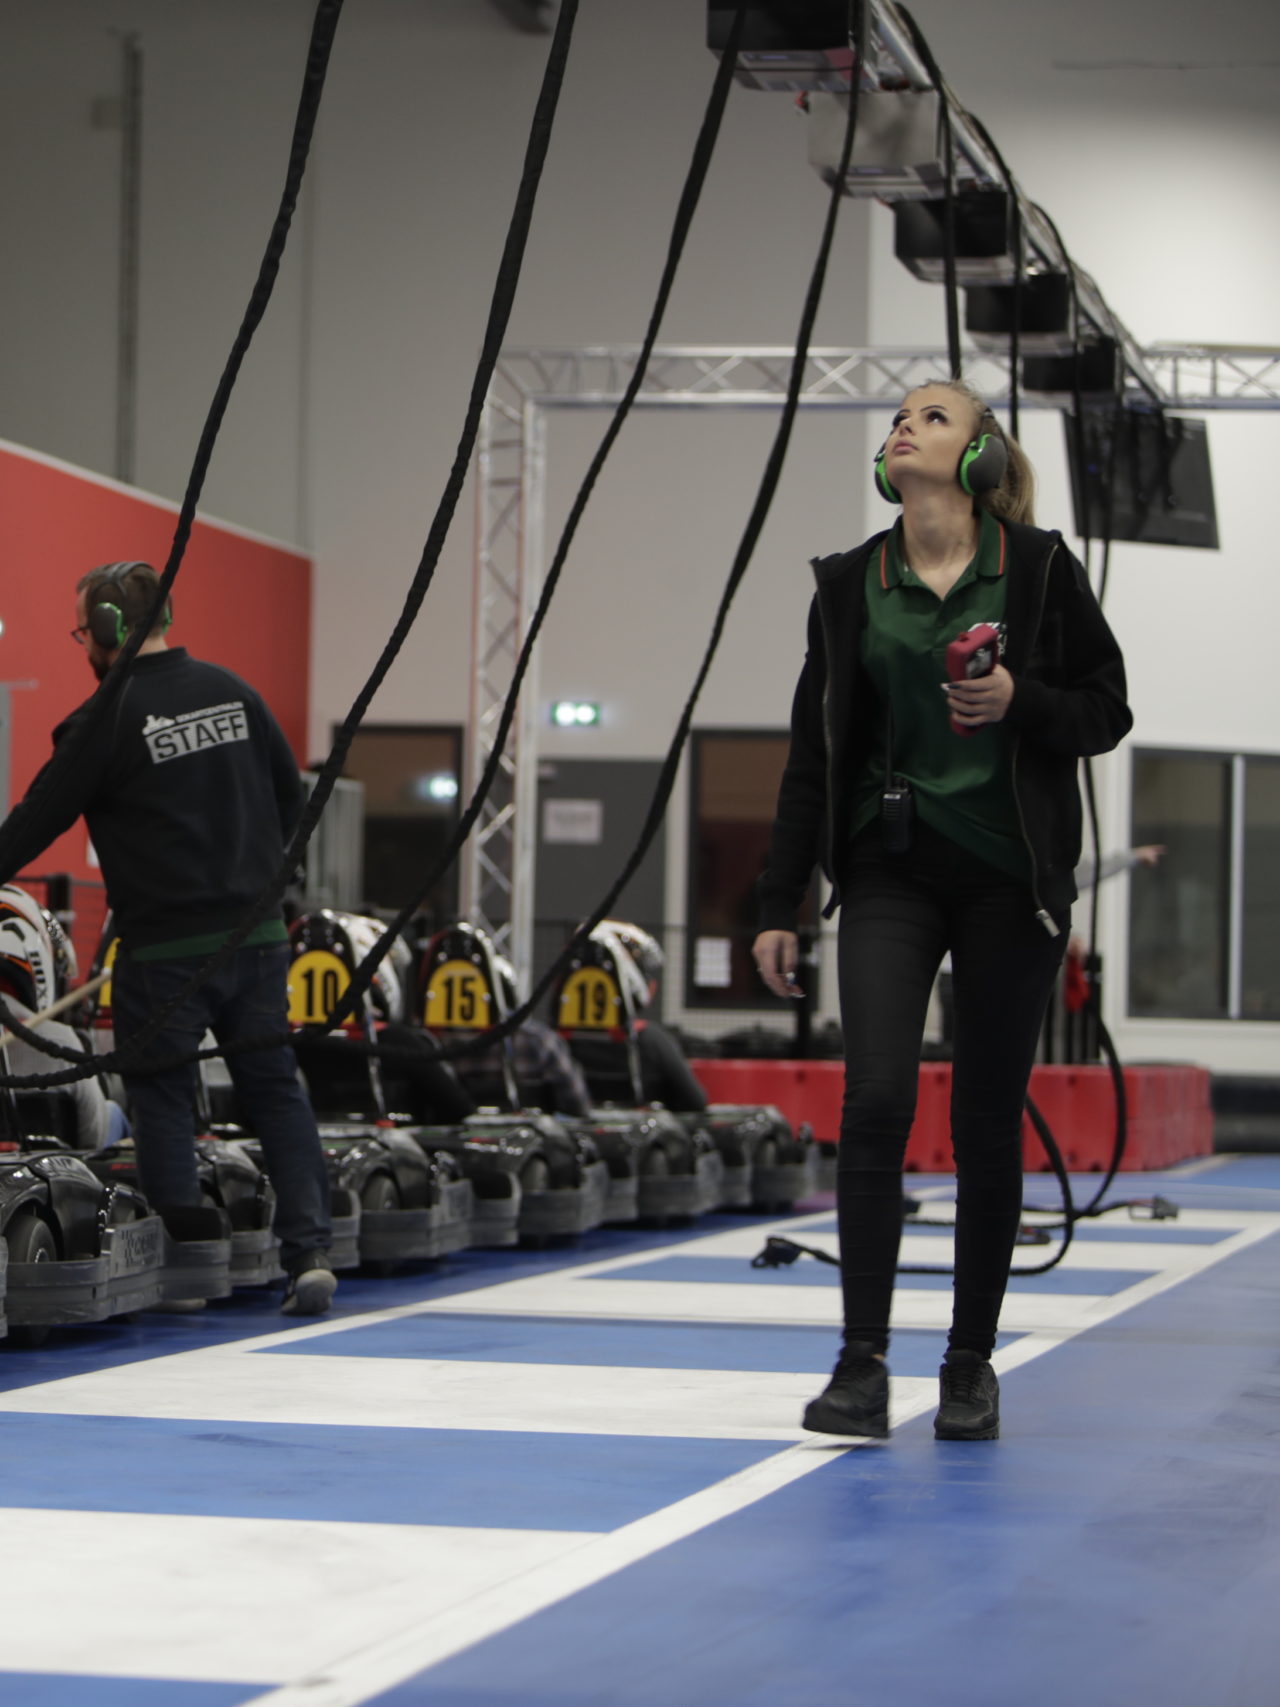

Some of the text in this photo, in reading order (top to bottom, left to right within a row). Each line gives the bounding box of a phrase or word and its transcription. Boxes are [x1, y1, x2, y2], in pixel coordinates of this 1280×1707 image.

[154, 714, 243, 759] STAFF
[301, 967, 338, 1016] 10
[443, 976, 475, 1021] 15
[576, 982, 608, 1021] 19
